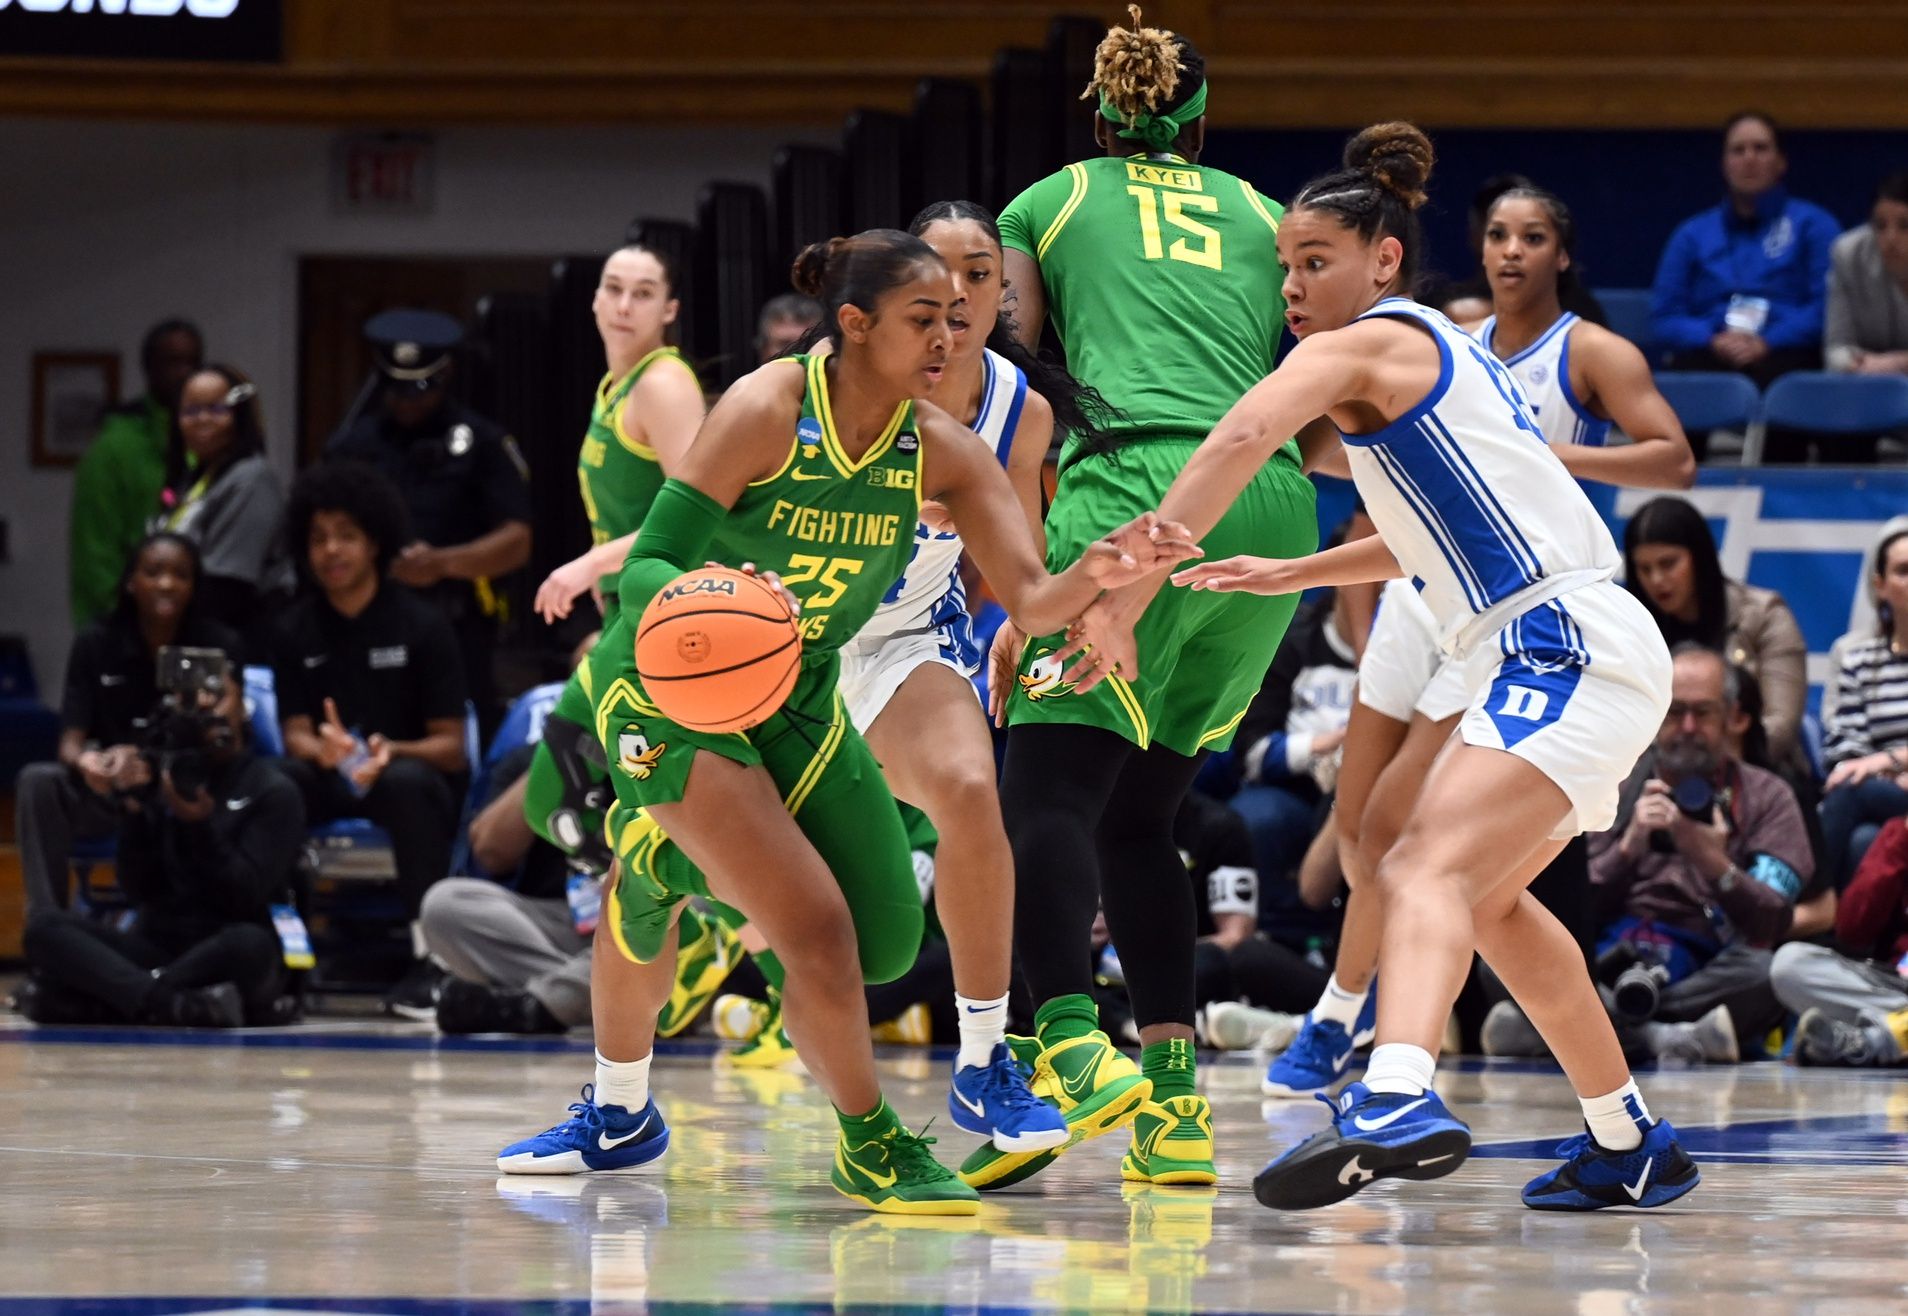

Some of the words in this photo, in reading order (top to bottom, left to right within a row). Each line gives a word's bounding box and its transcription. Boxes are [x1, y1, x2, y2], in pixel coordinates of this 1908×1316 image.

[1133, 165, 1196, 187] KYEI
[1126, 184, 1223, 271] 15
[866, 465, 915, 490] BIG
[766, 499, 900, 546] FIGHTING
[657, 578, 736, 607] NCAA
[779, 552, 865, 609] 25
